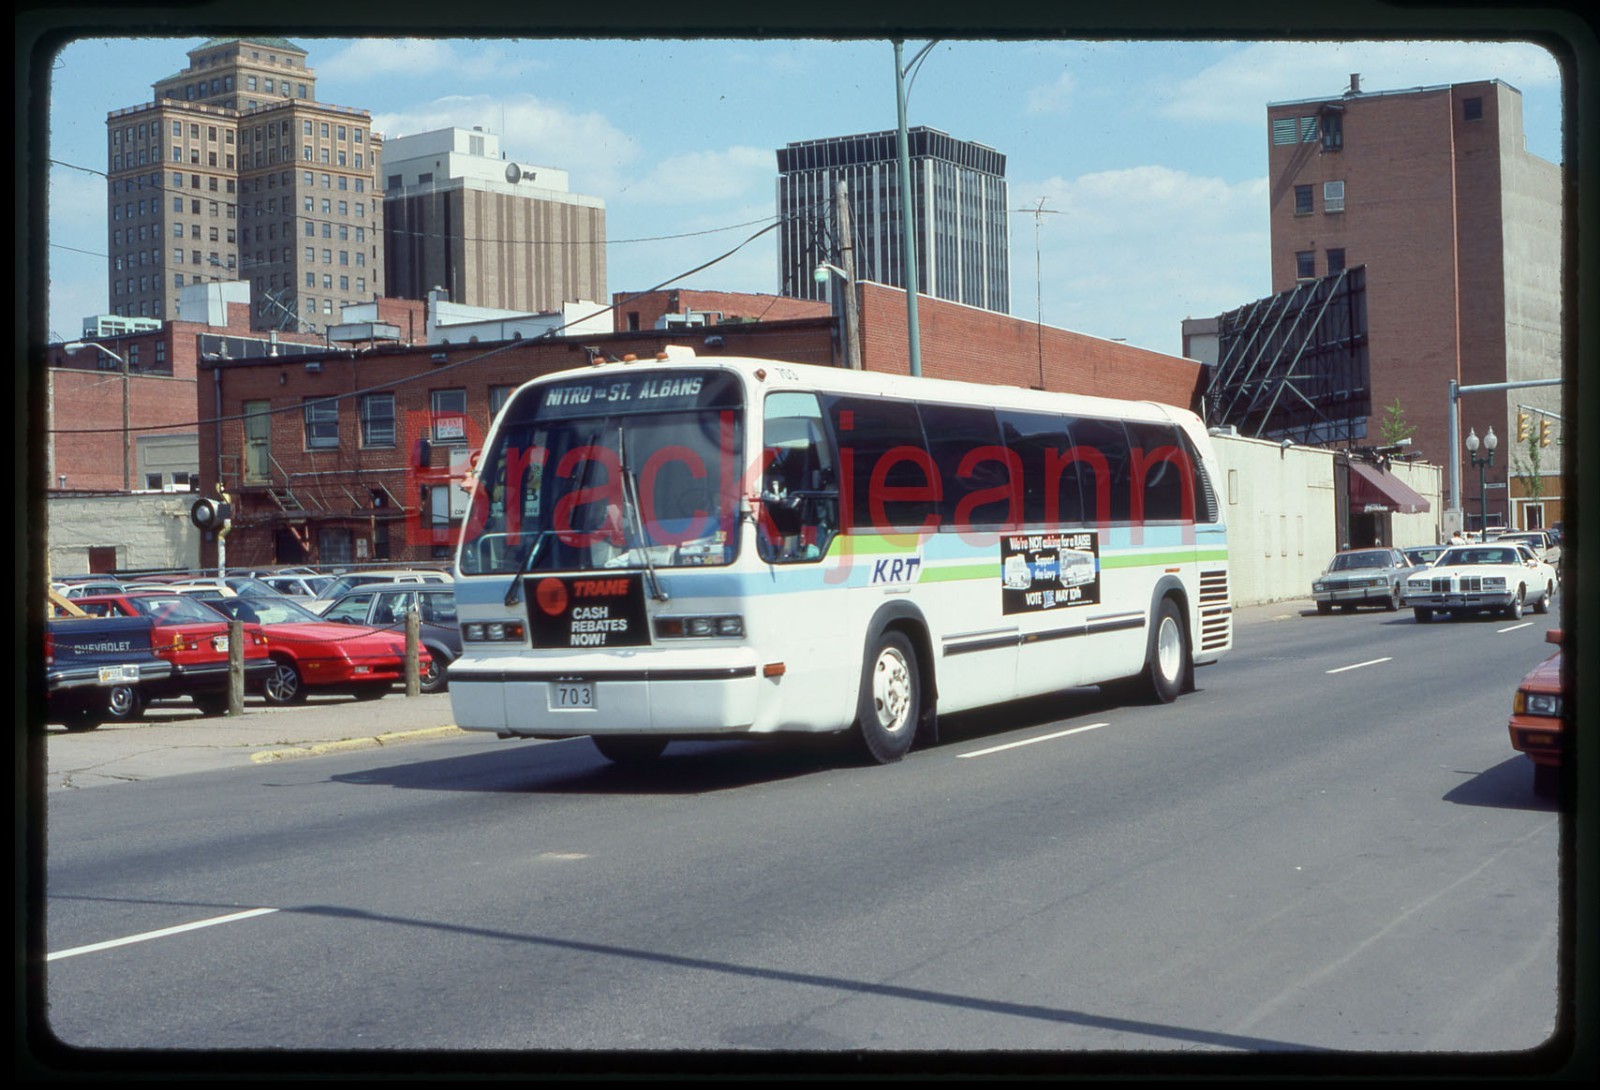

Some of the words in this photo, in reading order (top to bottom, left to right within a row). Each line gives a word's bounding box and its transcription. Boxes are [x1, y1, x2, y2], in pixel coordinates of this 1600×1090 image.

[546, 385, 593, 406] NITRO
[608, 382, 631, 401] ST.
[639, 377, 704, 400] ALBANS
[1009, 537, 1028, 551] We're
[1028, 535, 1042, 550] NOT
[1061, 533, 1070, 547] for
[872, 556, 921, 583] KRT
[573, 578, 630, 597] TRANE
[1025, 592, 1042, 606] VOTE
[1055, 589, 1069, 602] MAY
[572, 606, 609, 619] CASH
[571, 619, 628, 632] REBATES
[74, 641, 131, 654] CHEVROLET
[570, 633, 607, 646] NOW!
[559, 687, 591, 705] 703
